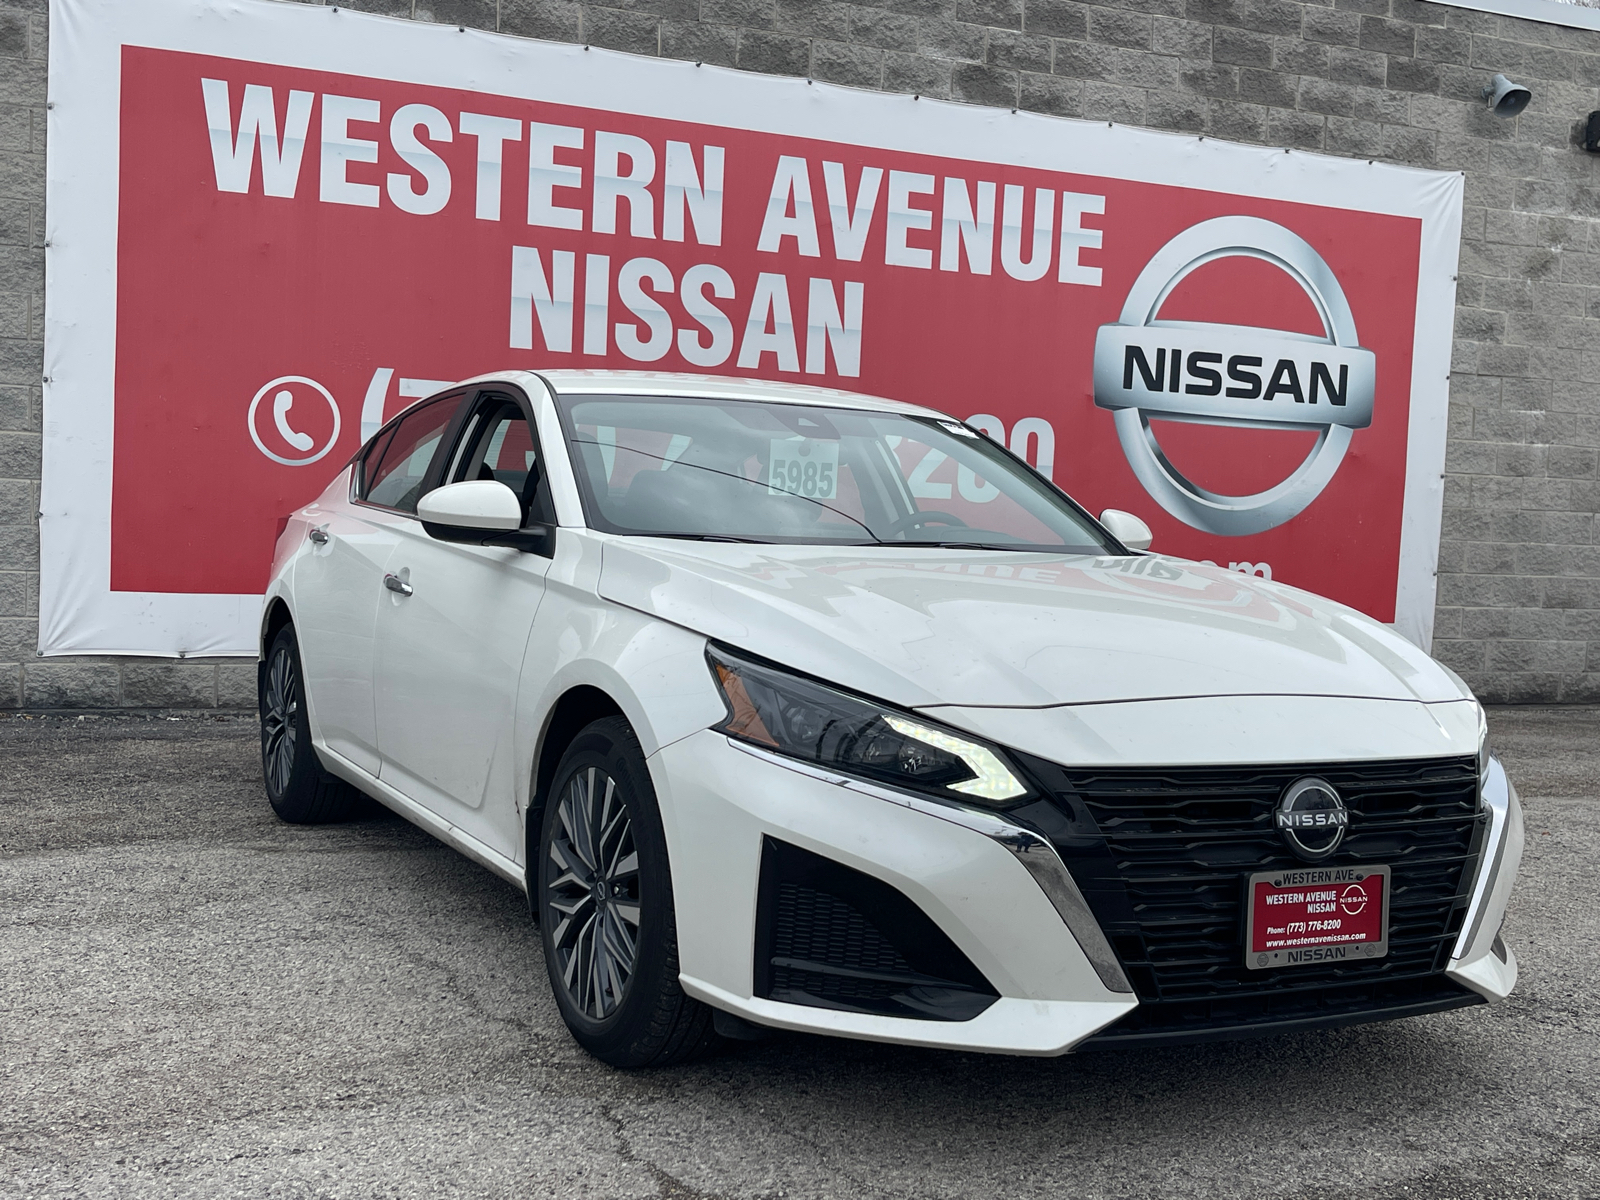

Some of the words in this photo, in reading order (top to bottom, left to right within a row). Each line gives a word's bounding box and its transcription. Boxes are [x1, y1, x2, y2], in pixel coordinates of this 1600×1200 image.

[201, 78, 725, 246] WESTERN
[757, 155, 1105, 286] AVENUE
[510, 246, 864, 377] NISSAN
[1123, 346, 1348, 406] NISSAN
[771, 459, 833, 497] 5985
[1279, 812, 1348, 826] NISSAN
[1283, 871, 1331, 885] WESTERN
[1266, 893, 1304, 905] WESTERN
[1305, 891, 1336, 902] AVENUE
[1307, 902, 1336, 913] NISSAN
[1267, 926, 1286, 934] Phone:
[1287, 922, 1306, 935] (773)
[1308, 919, 1341, 931] 776-8200
[1266, 933, 1366, 947] www.westernavenissan.com
[1287, 947, 1346, 962] NISSAN
